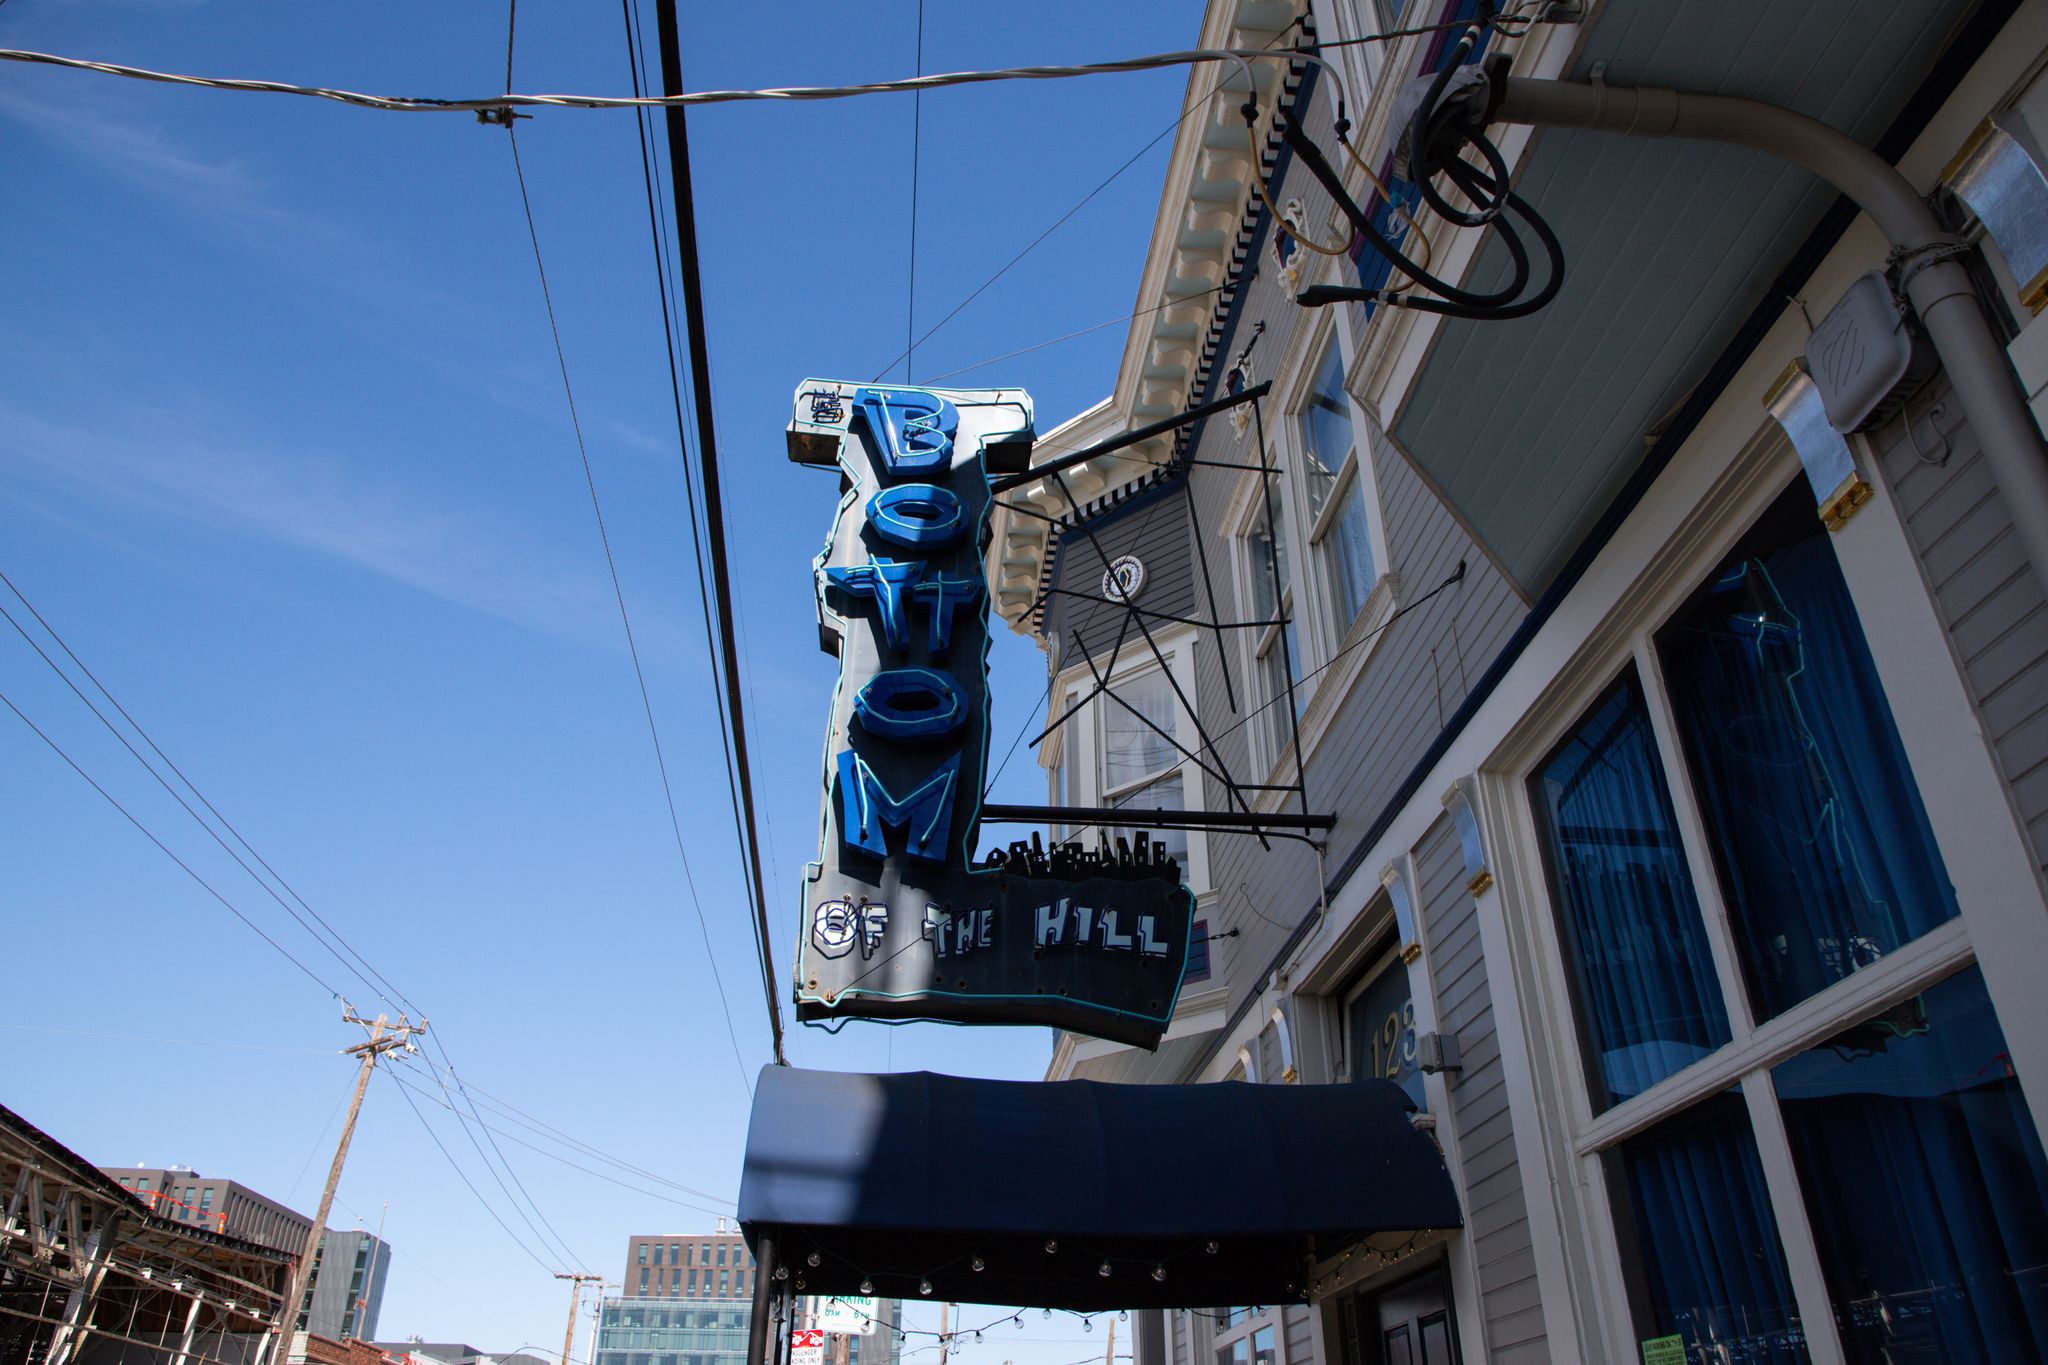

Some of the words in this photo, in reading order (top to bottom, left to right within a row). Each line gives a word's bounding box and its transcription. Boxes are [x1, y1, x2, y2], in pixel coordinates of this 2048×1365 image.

[827, 386, 986, 862] BOTTOM
[814, 900, 889, 952] OF
[925, 902, 993, 957] THE
[1033, 897, 1168, 958] HILL
